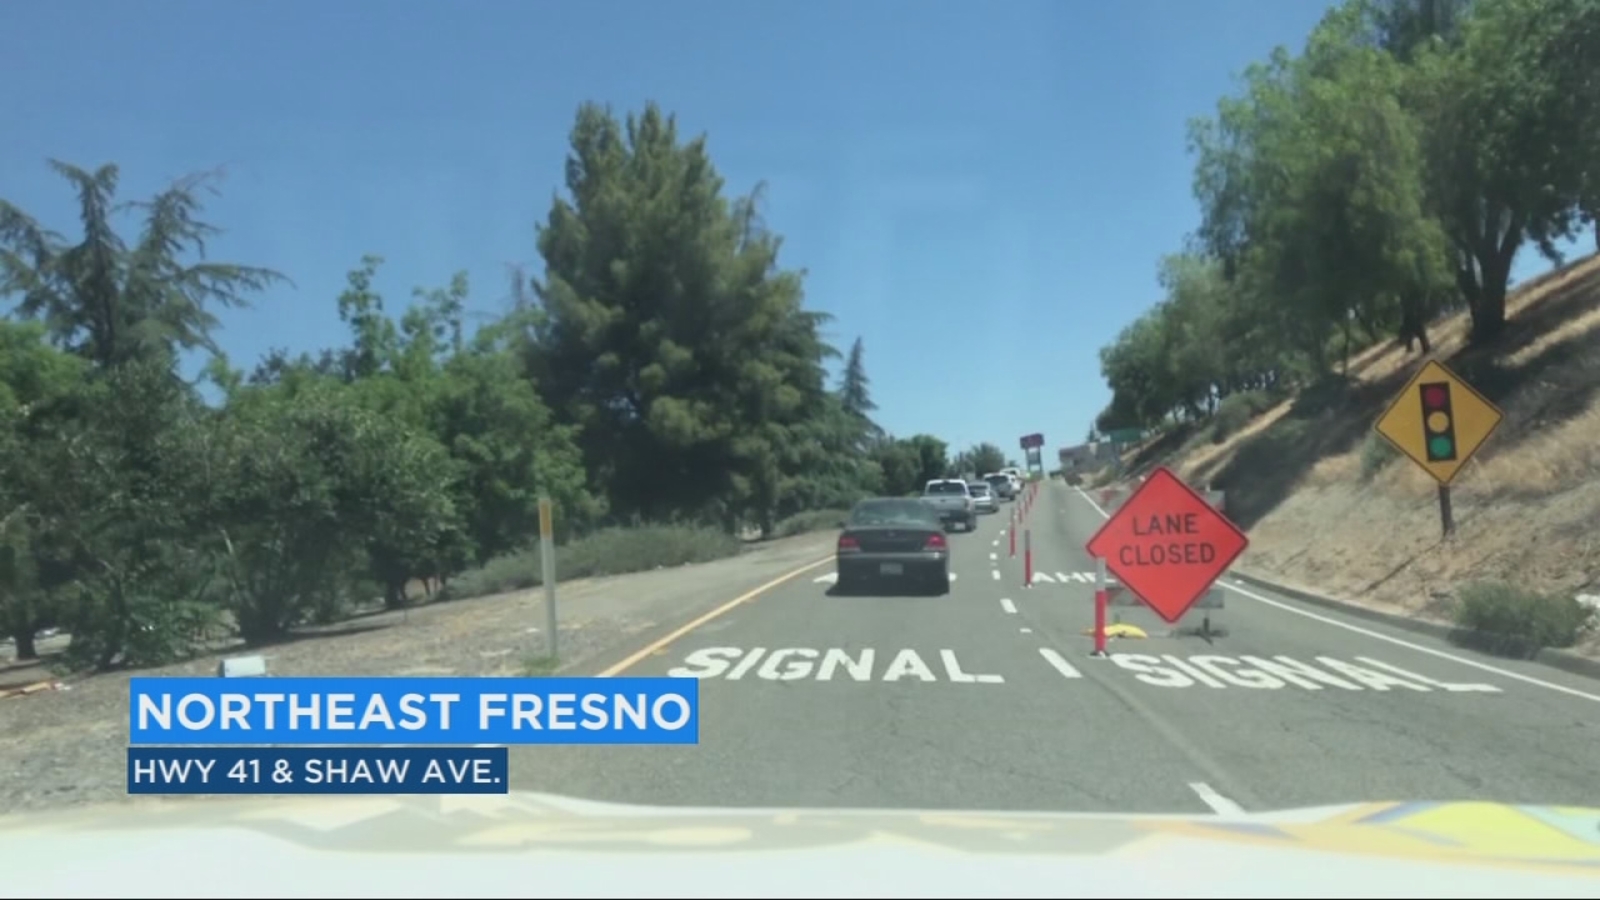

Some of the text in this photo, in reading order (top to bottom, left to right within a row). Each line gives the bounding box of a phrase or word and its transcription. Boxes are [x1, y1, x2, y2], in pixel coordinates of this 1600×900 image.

[1132, 512, 1199, 537] LANE
[1119, 542, 1216, 567] CLOSED
[669, 646, 1004, 684] SIGNAL
[1110, 653, 1503, 692] SIGNAL
